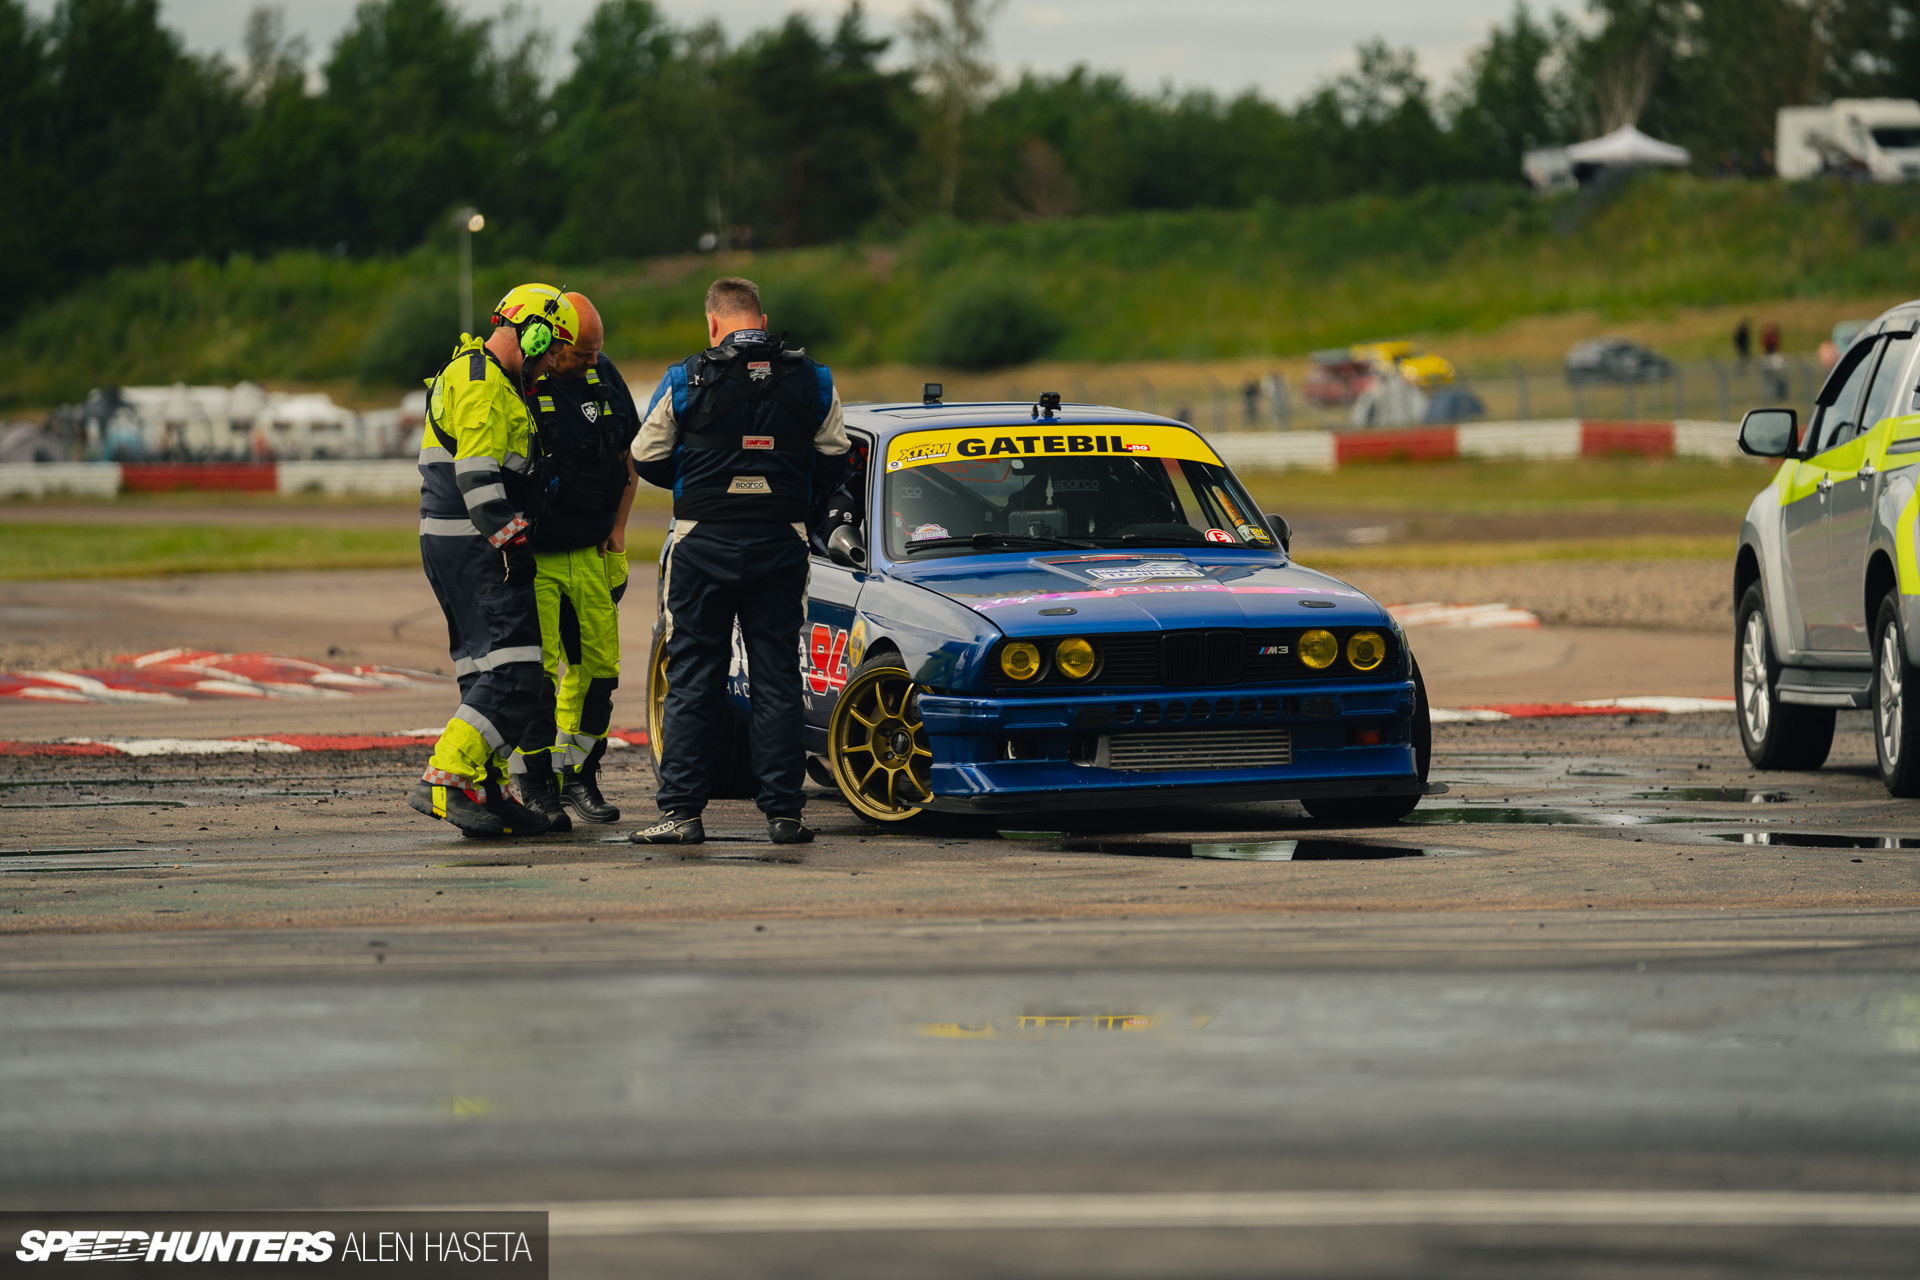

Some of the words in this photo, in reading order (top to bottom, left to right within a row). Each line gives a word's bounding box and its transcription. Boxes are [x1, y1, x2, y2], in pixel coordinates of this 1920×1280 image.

[898, 443, 951, 461] XTRM
[736, 482, 763, 490] sparco
[1053, 479, 1100, 492] sparco
[1265, 646, 1289, 655] M3
